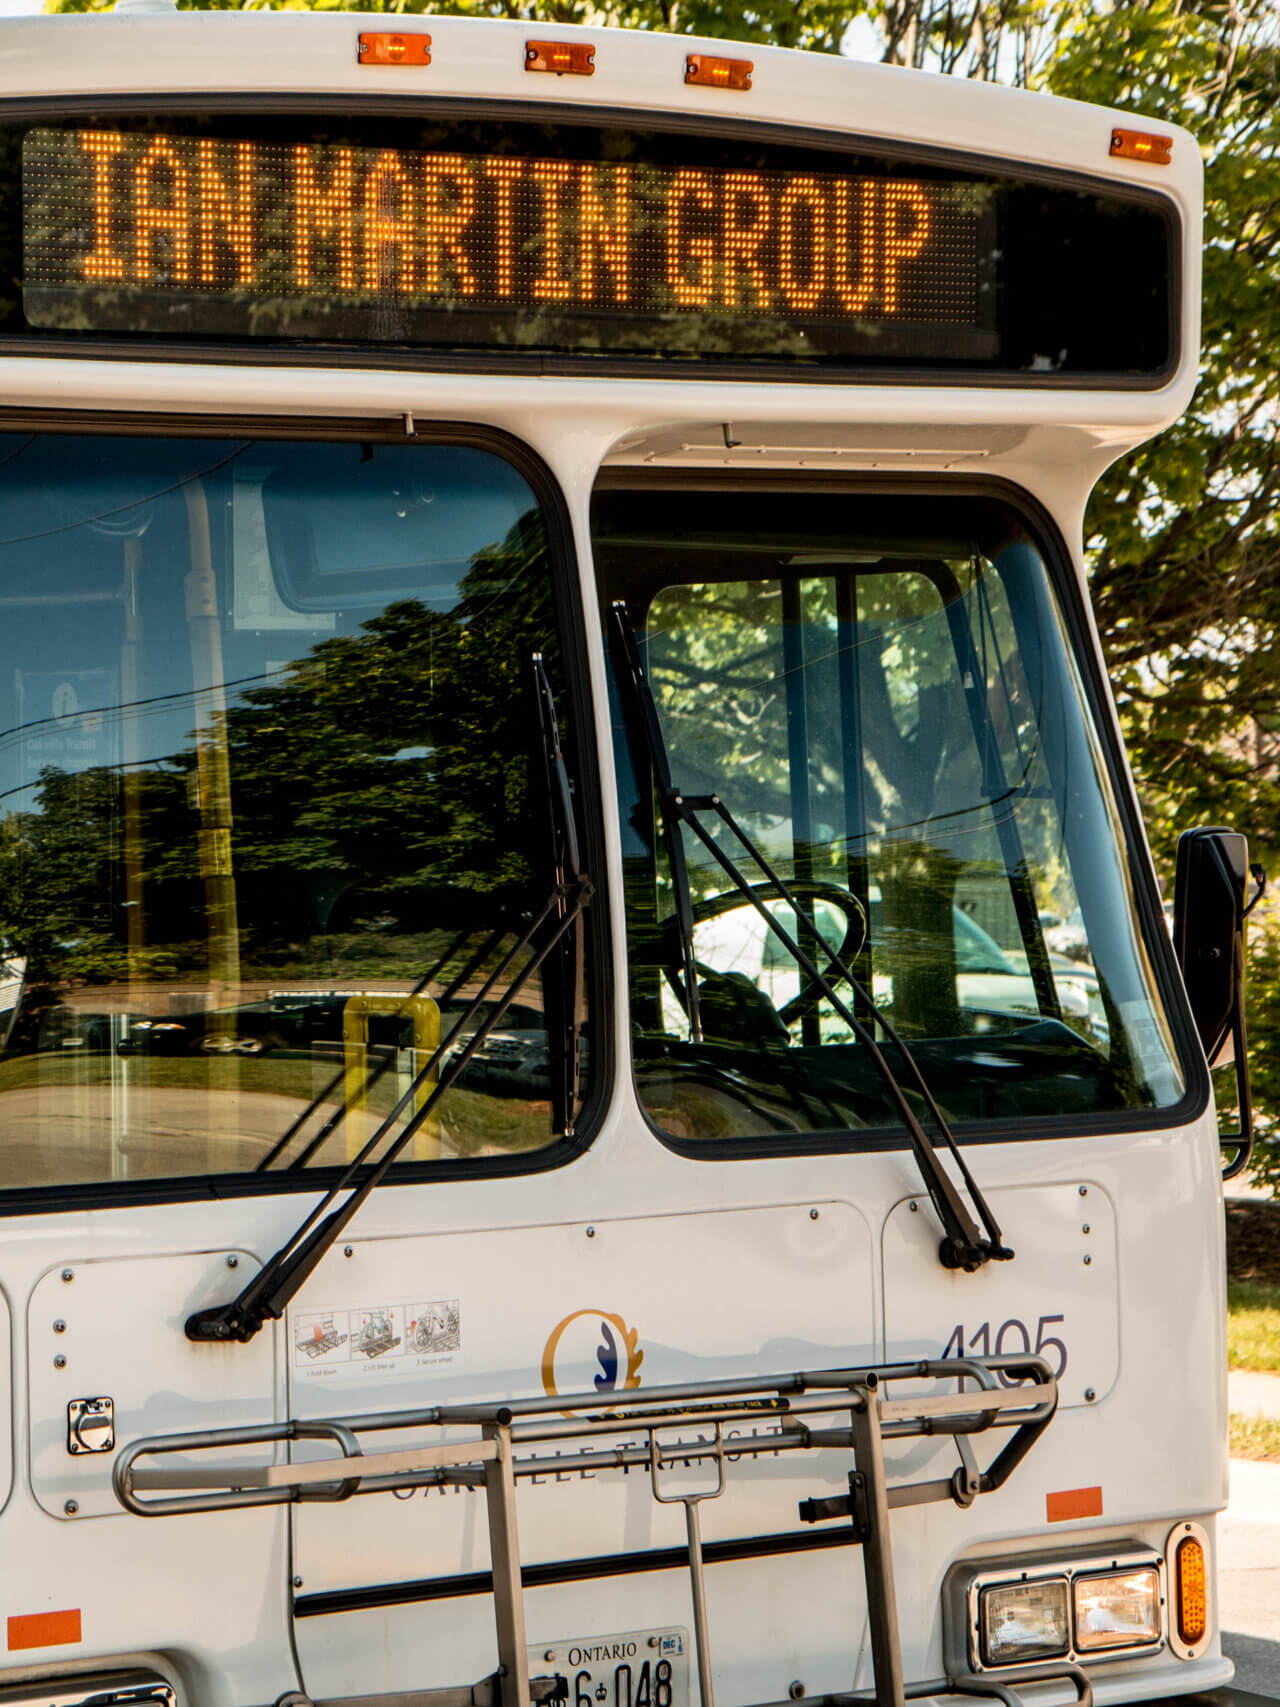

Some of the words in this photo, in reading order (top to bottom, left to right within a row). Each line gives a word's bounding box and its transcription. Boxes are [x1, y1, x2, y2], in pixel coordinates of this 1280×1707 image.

[80, 130, 254, 284] IAN
[294, 145, 629, 303] MARTIN
[666, 169, 930, 315] GROUP
[568, 1641, 638, 1667] ONTARIO
